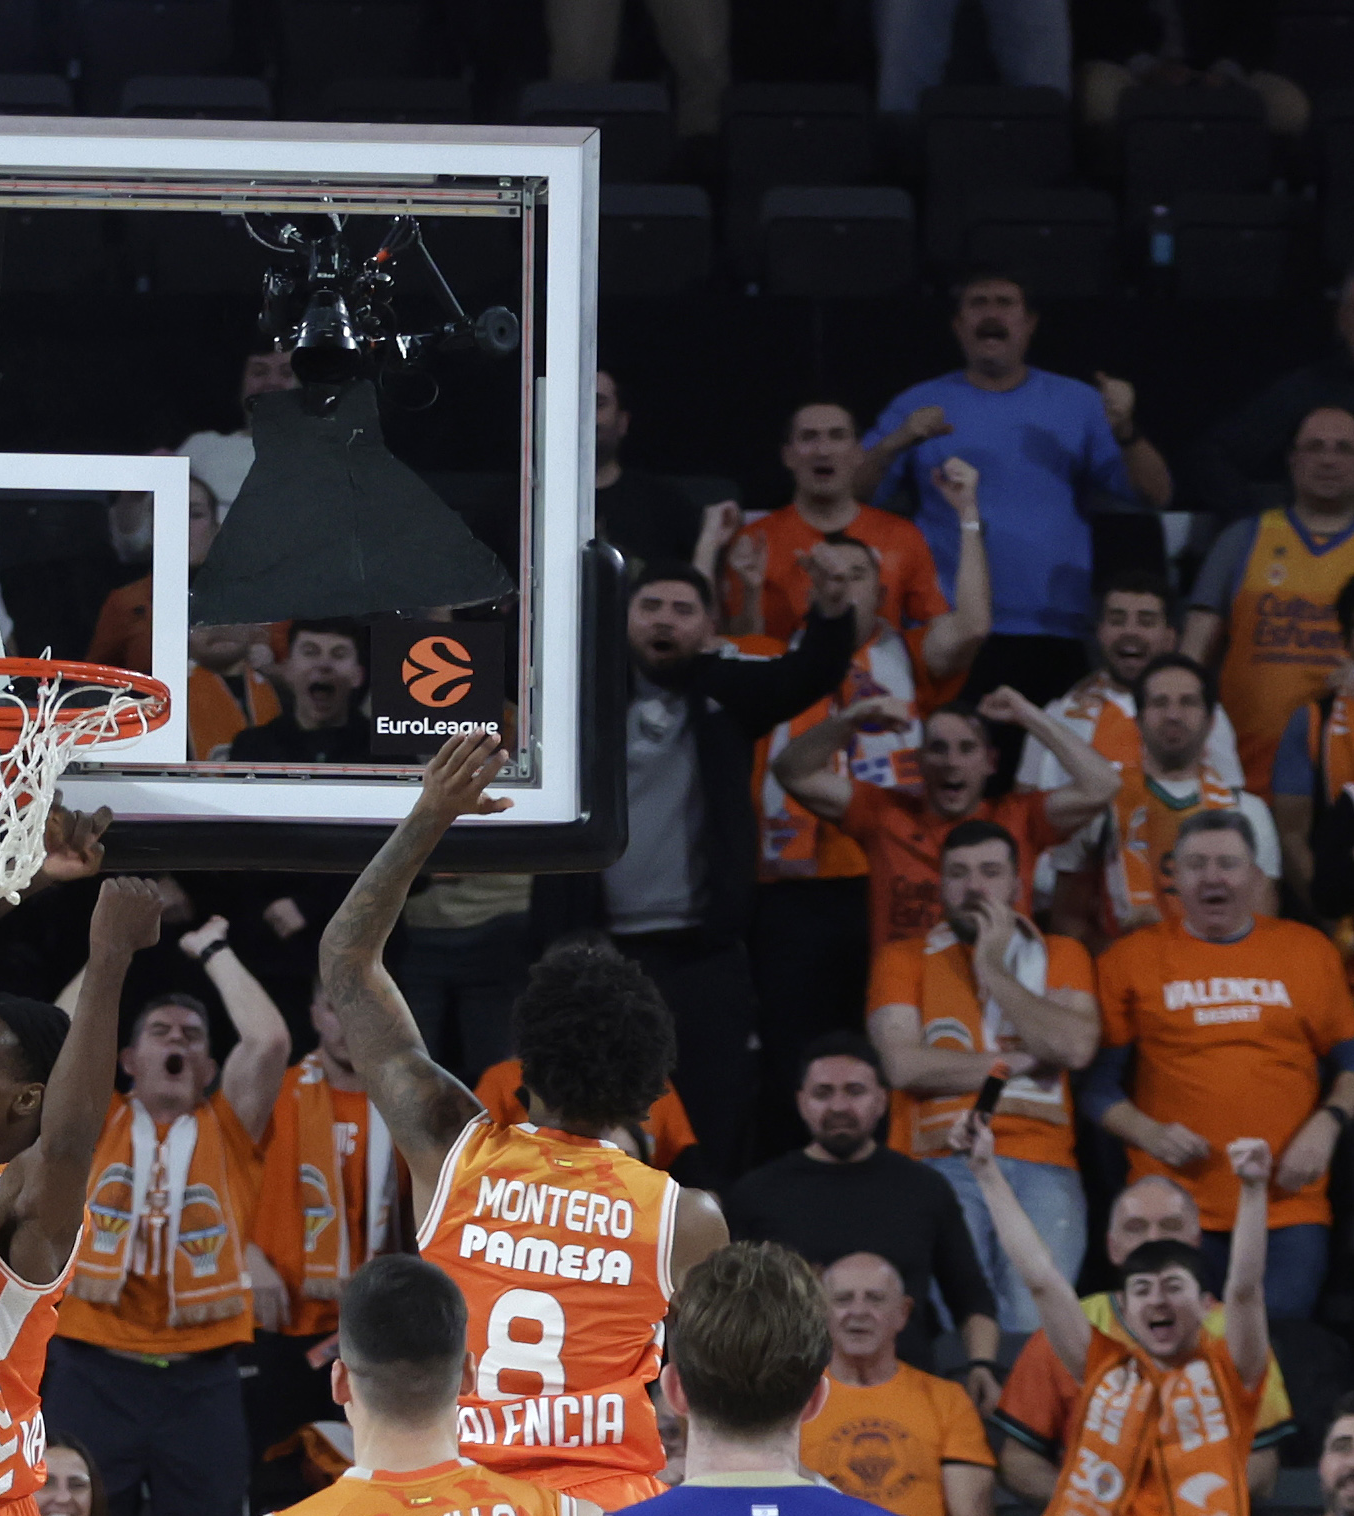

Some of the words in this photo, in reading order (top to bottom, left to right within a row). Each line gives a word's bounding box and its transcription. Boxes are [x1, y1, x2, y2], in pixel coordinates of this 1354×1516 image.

[473, 1176, 633, 1239] MONTERO
[459, 1223, 633, 1286] PAMESA
[477, 1288, 566, 1401] 8
[456, 1393, 624, 1448] ALENCIA
